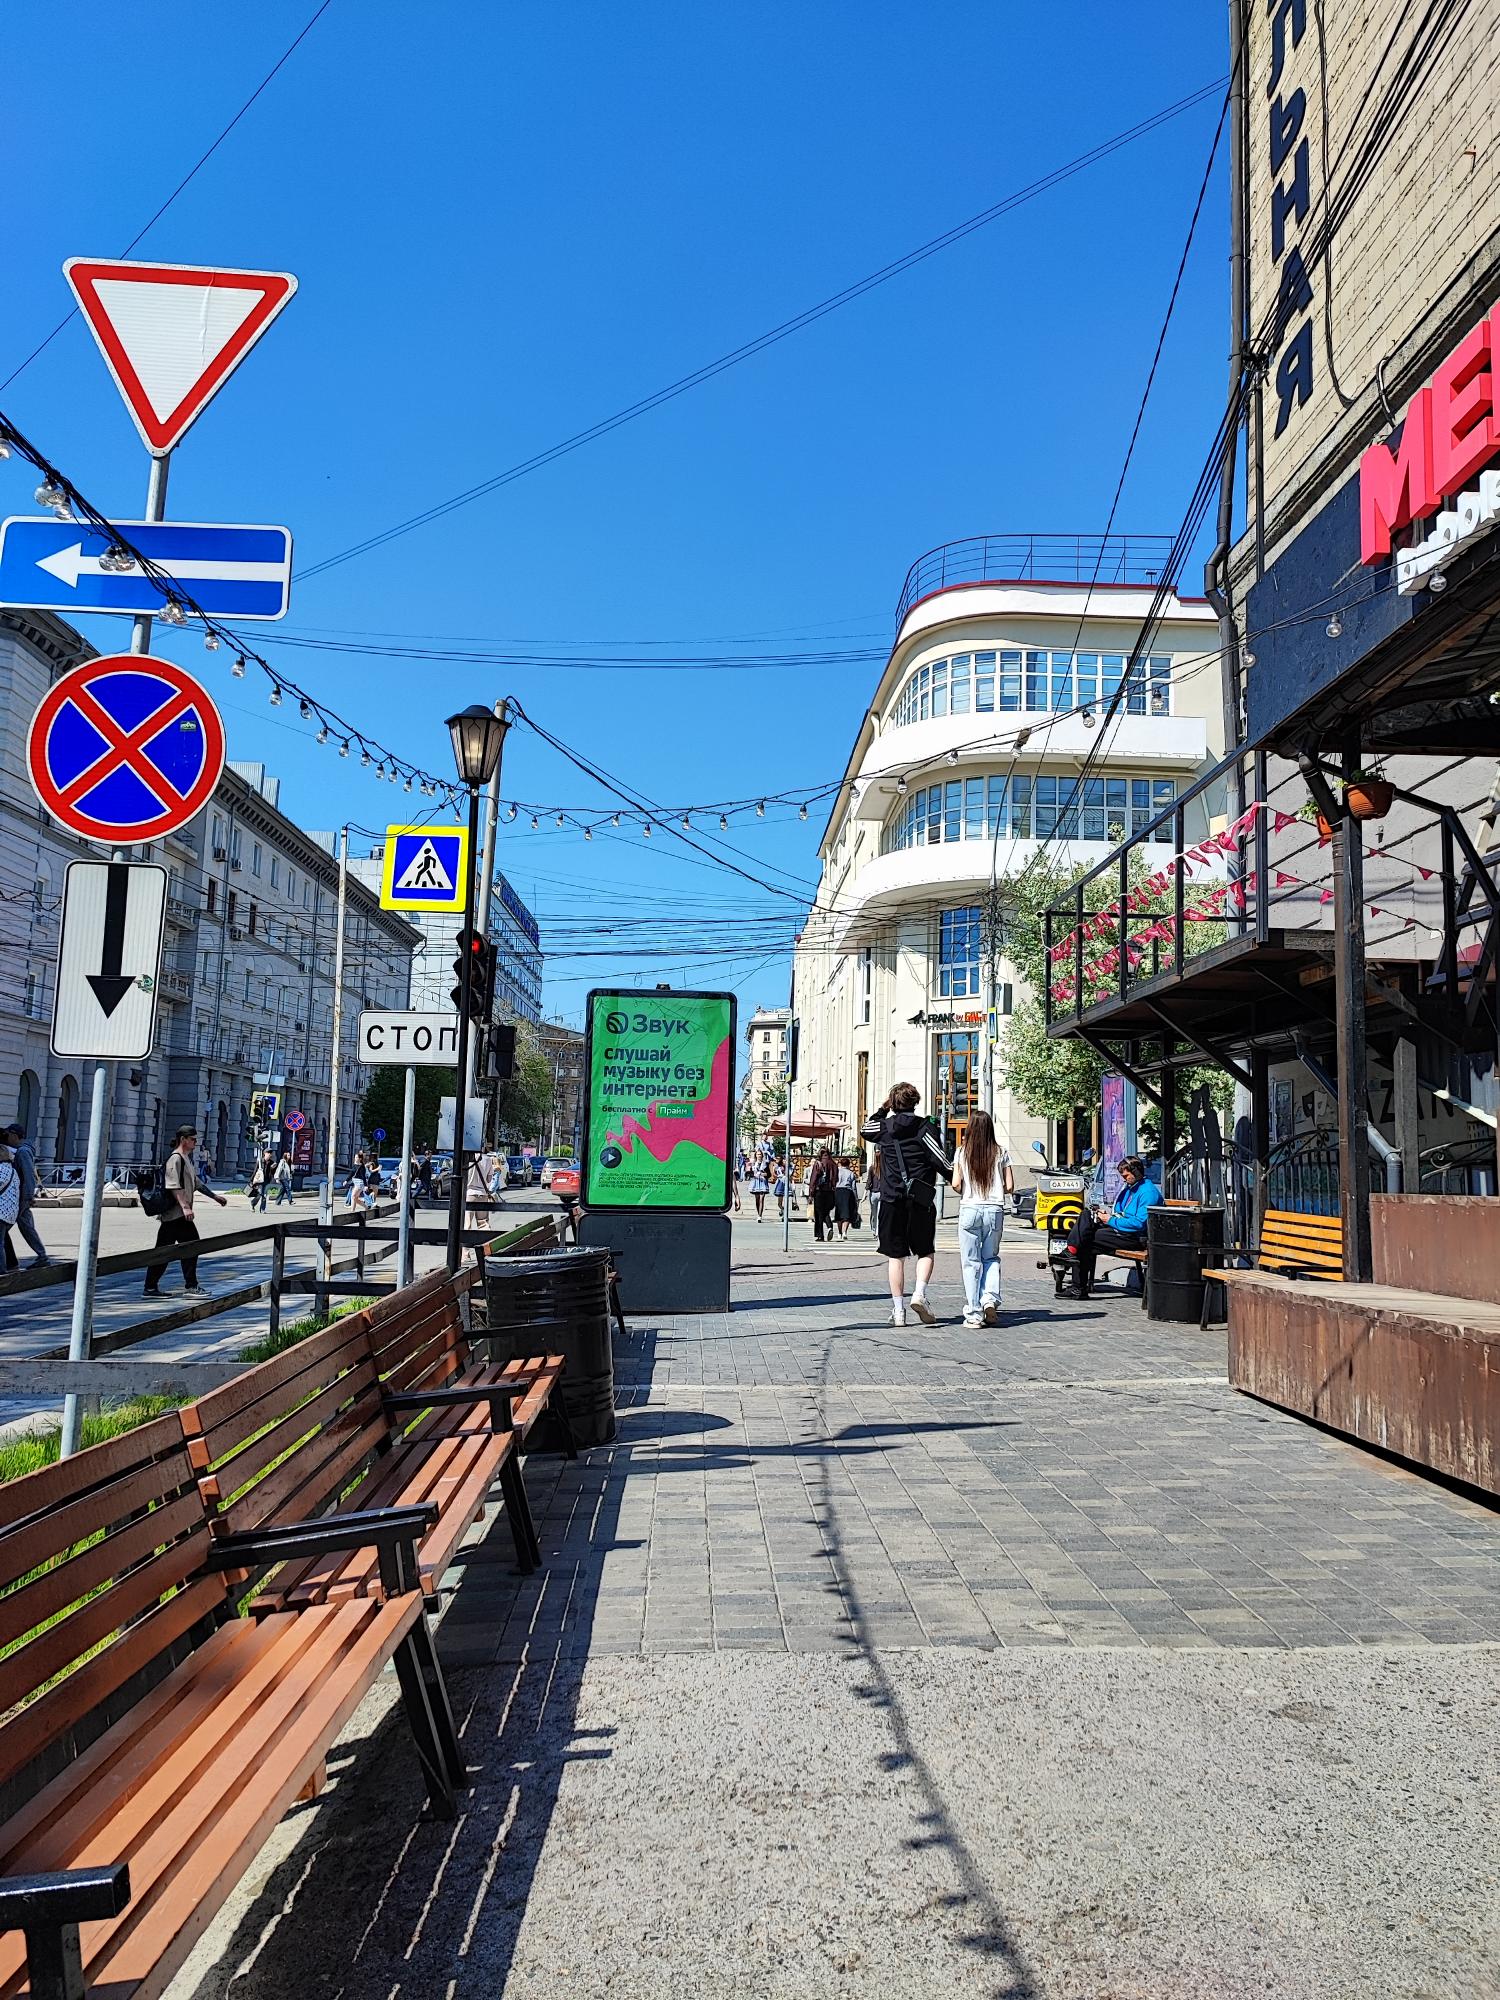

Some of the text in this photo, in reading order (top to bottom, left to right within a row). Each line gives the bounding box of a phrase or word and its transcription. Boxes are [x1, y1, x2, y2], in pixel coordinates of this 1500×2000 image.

[1267, 0, 1315, 440] ЛЬНАЯ
[1360, 298, 1500, 566] ME
[632, 1015, 690, 1037] Звук
[927, 1013, 955, 1023] FRANK
[366, 1025, 457, 1051] СТОП
[604, 1045, 671, 1064] слушай
[603, 1063, 705, 1082] музыку без
[602, 1083, 697, 1099] интернета
[602, 1104, 646, 1113] бесплатно
[659, 1106, 688, 1116] Прайм
[695, 1181, 711, 1191] 12+
